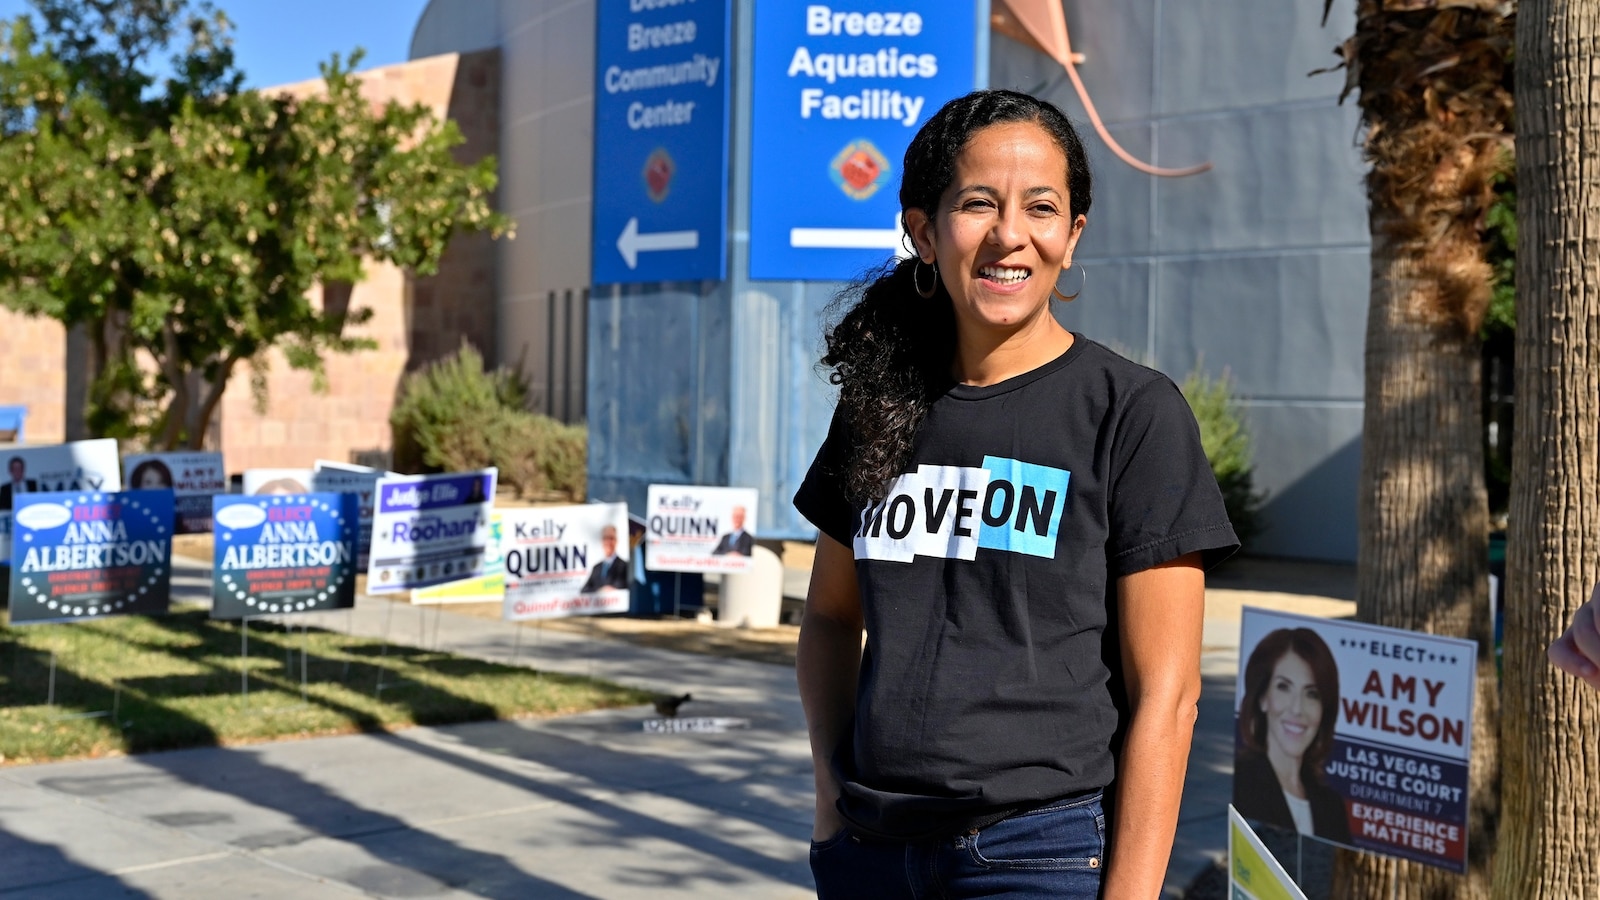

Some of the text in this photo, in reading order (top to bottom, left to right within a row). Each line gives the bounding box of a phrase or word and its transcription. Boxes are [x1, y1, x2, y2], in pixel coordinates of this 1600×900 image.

[628, 19, 697, 52] Breeze
[806, 5, 922, 36] Breeze
[605, 53, 720, 94] Community
[788, 47, 937, 83] Aquatics
[627, 99, 696, 130] Center
[801, 89, 925, 127] Facility
[386, 488, 430, 507] Judge
[659, 493, 703, 512] Kelly
[268, 506, 313, 522] ELECT
[392, 512, 479, 542] Roohani
[515, 519, 567, 540] Kelly
[650, 514, 718, 536] QUINN
[63, 520, 128, 544] ANNA
[259, 520, 319, 544] ANNA
[20, 540, 167, 573] ALBERTSON
[221, 541, 352, 570] ALBERTSON
[506, 544, 588, 578] QUINN
[1369, 640, 1427, 664] ELECT
[1362, 669, 1446, 707] AMY
[1340, 698, 1464, 747] WILSON
[1346, 746, 1442, 780] LAS VEGAS
[1326, 759, 1463, 802] JUSTICE COURT
[1350, 784, 1443, 816] DEPARTMENT 7
[1351, 803, 1459, 841] EXPERIENCE
[1362, 822, 1447, 855] MATTERS
